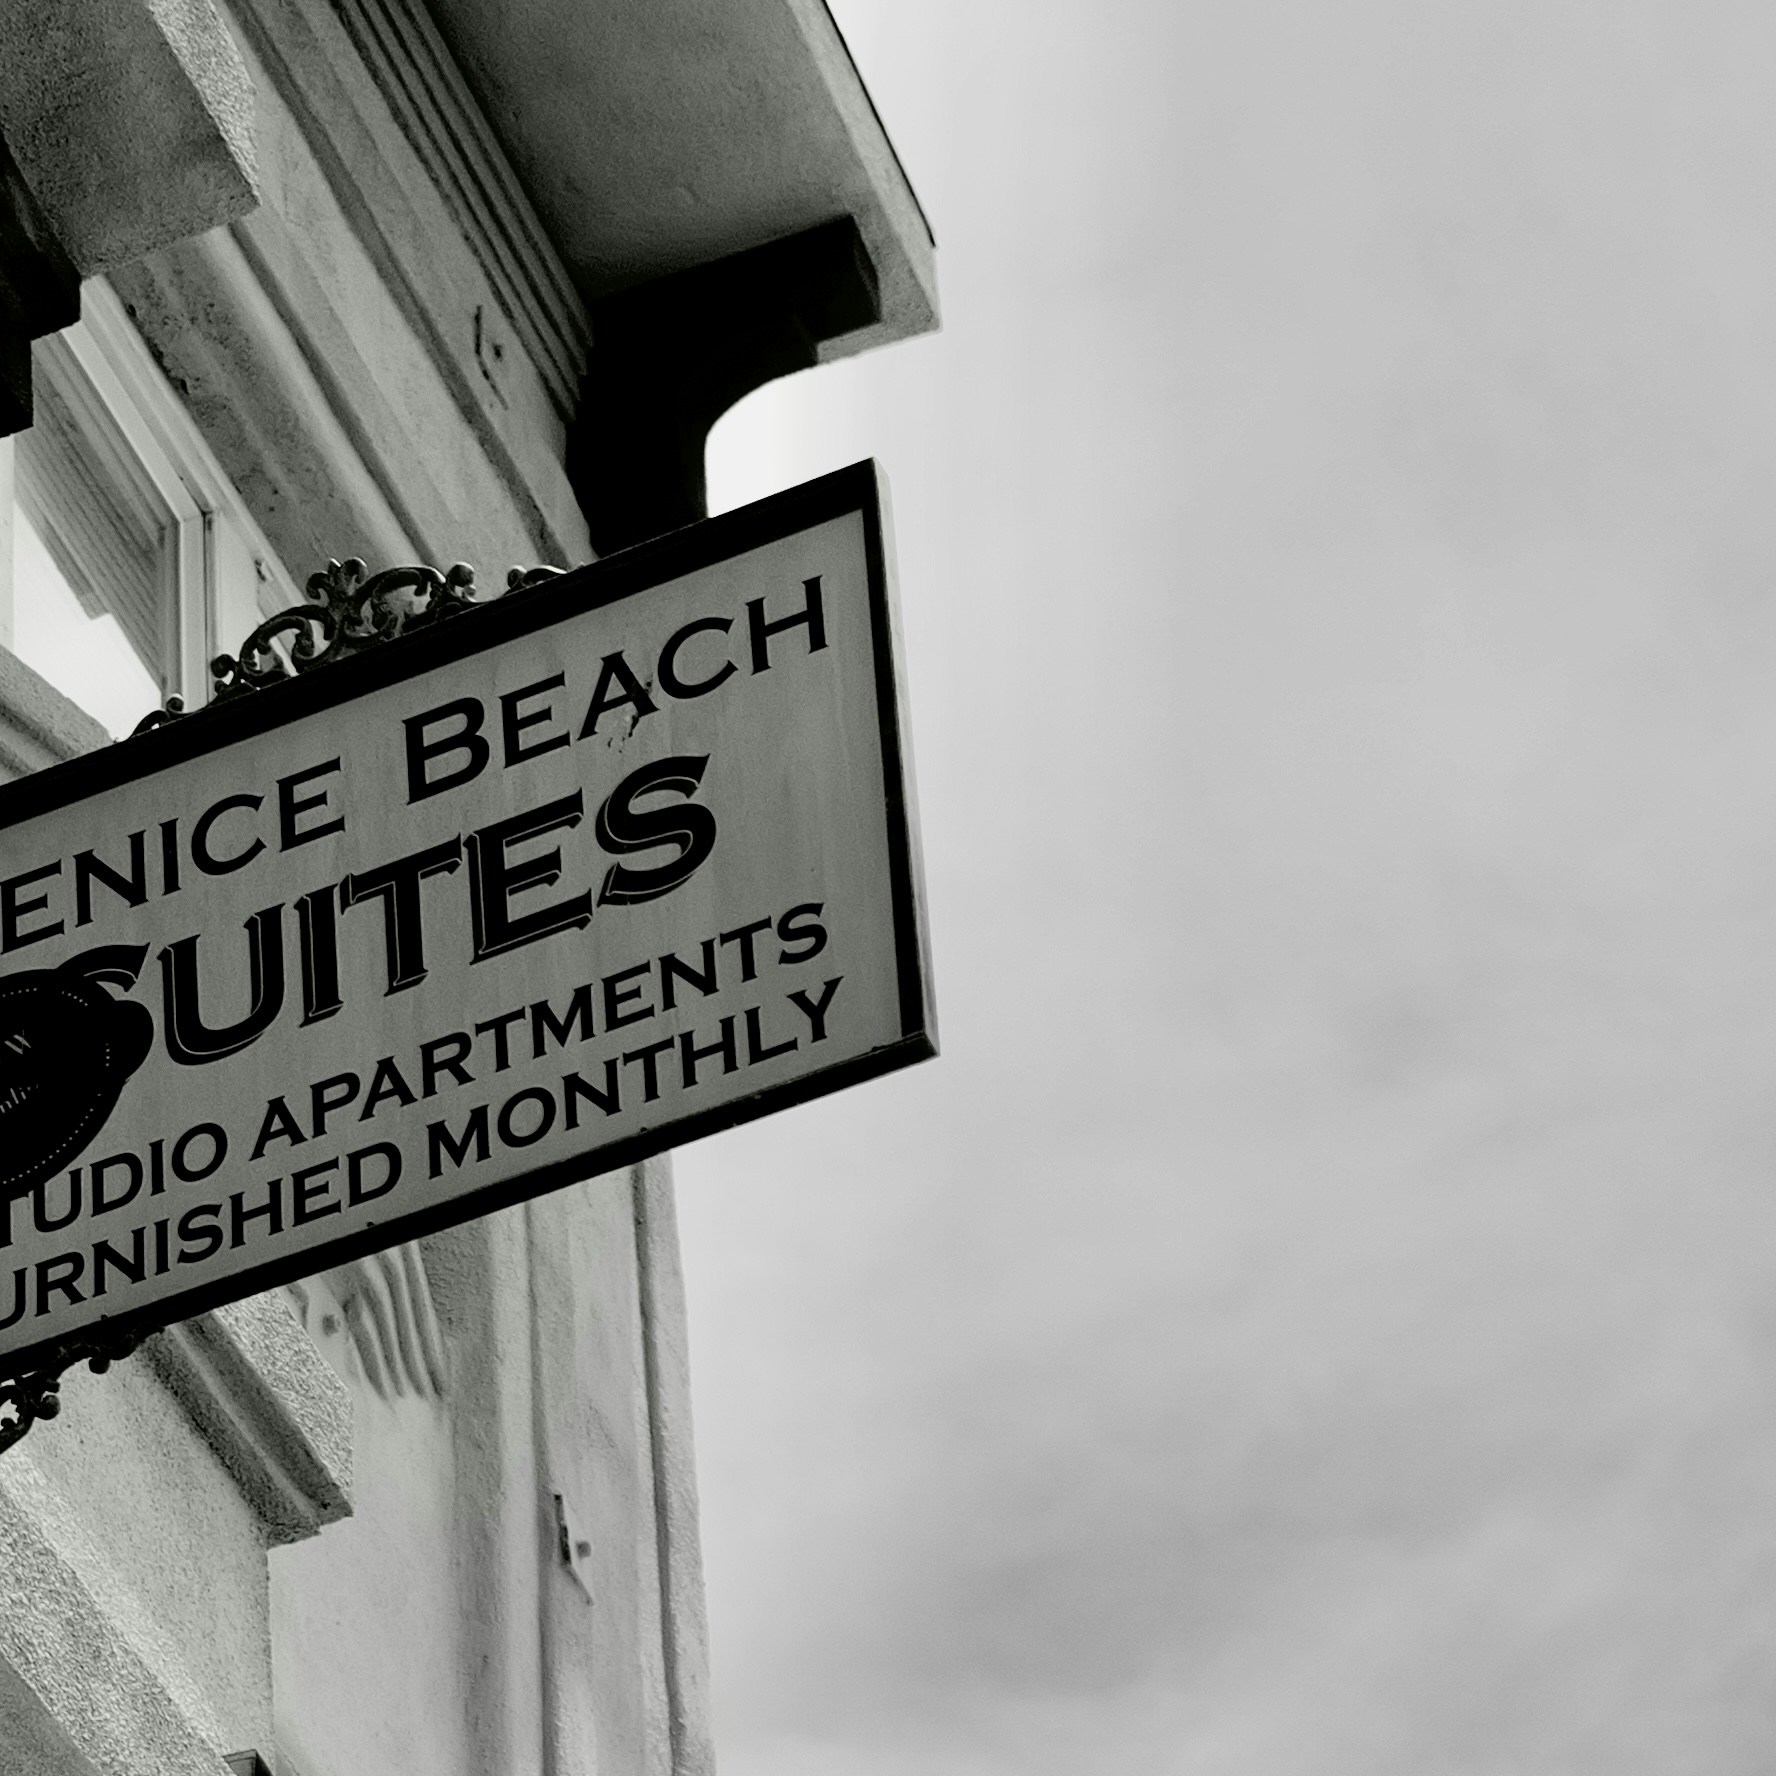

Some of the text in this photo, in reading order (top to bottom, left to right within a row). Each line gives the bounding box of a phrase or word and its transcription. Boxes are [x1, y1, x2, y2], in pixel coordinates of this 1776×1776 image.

[402, 575, 828, 805] BEACH
[249, 903, 827, 1161] APARTMENTS
[426, 976, 843, 1179] MONTHLY
